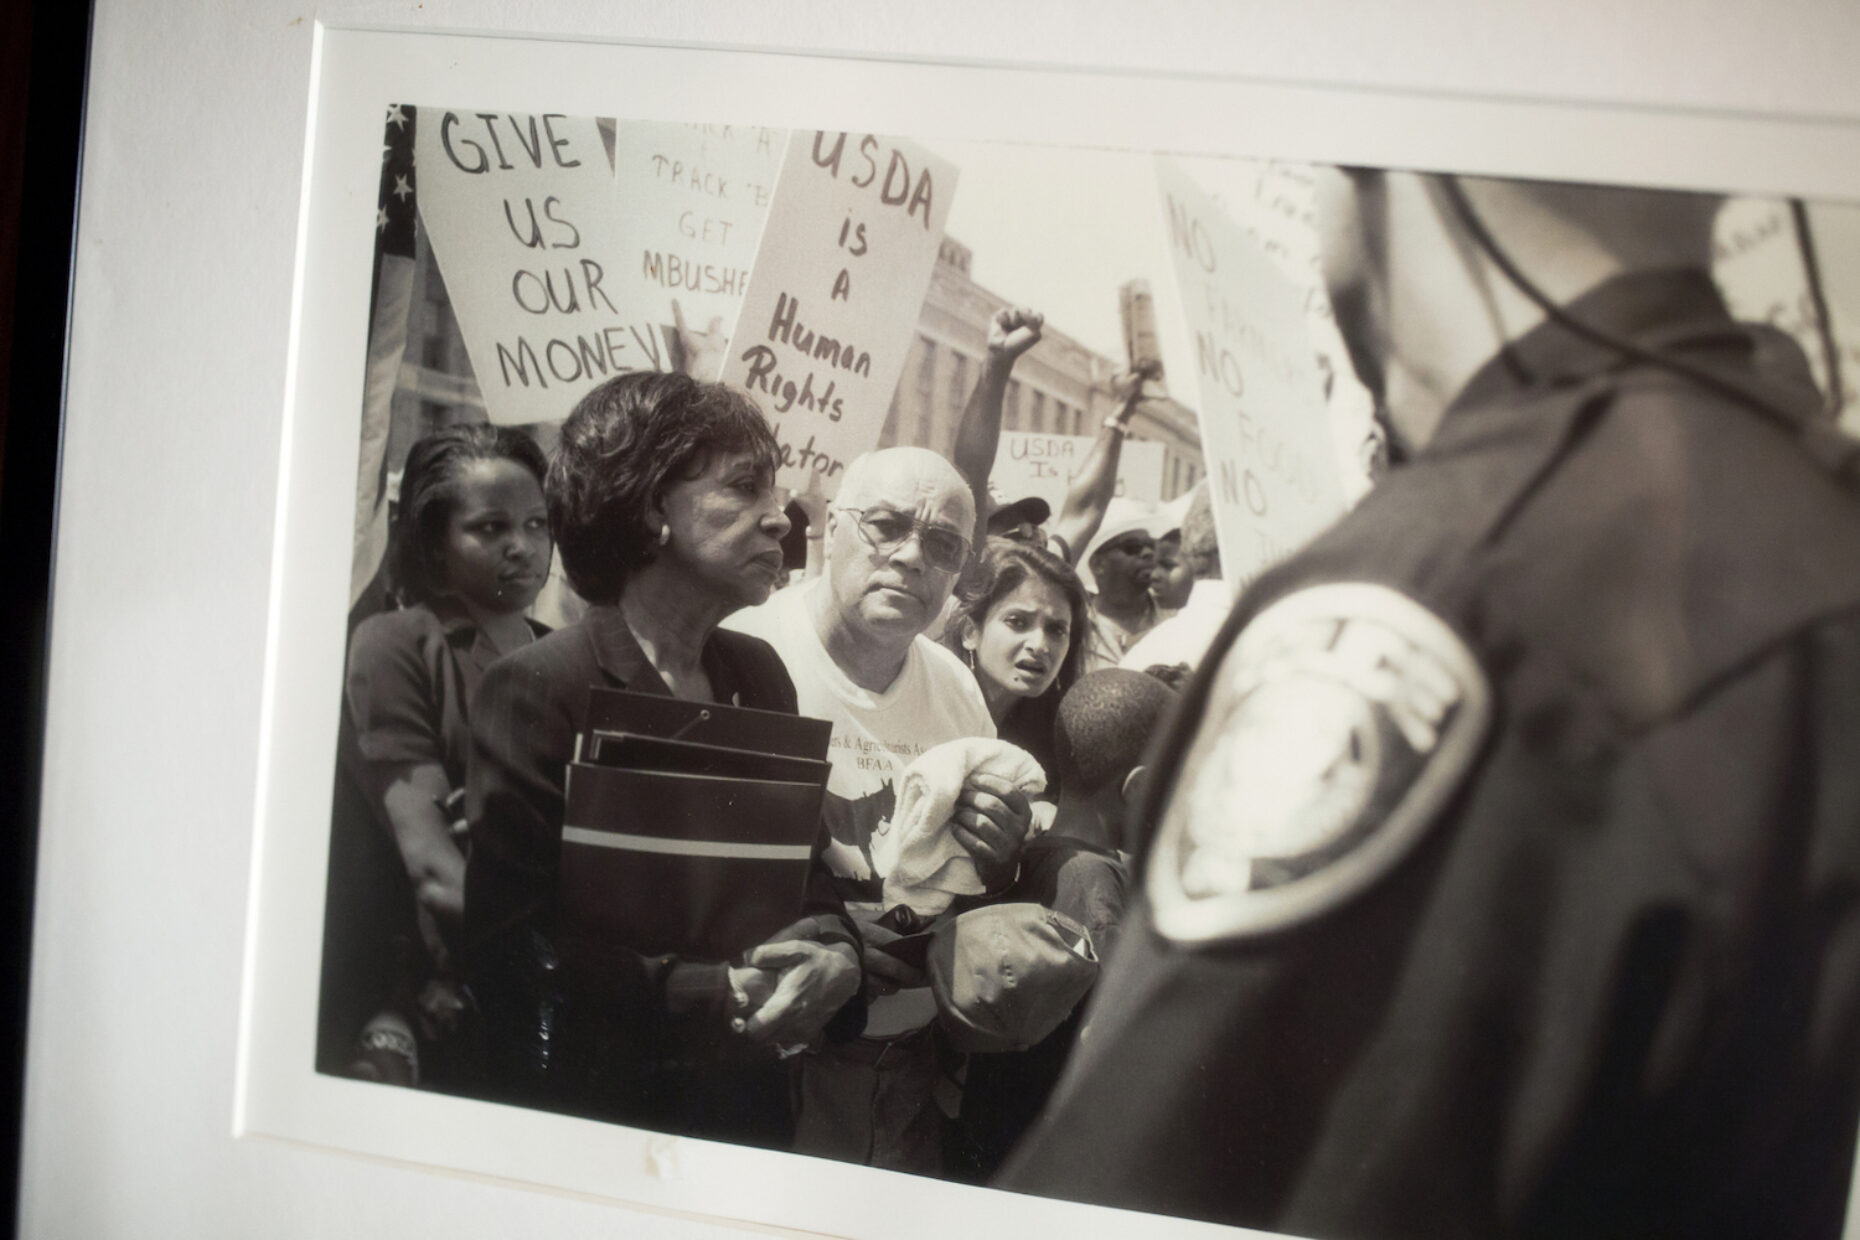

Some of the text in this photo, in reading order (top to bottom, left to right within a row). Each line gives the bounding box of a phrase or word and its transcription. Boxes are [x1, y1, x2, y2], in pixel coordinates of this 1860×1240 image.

[440, 111, 581, 175] GIVE
[651, 153, 728, 200] TRACK
[811, 131, 932, 231] USDA
[503, 196, 580, 249] US
[678, 210, 733, 246] GET
[1166, 192, 1217, 274] NO
[512, 258, 619, 315] OUR
[830, 267, 851, 302] A
[496, 323, 662, 389] MONEY
[768, 291, 871, 379] Human
[1195, 329, 1244, 398] NO
[741, 344, 844, 422] Rights
[1010, 437, 1075, 461] USDA
[1220, 457, 1268, 517] NO
[856, 757, 894, 771] BFAA
